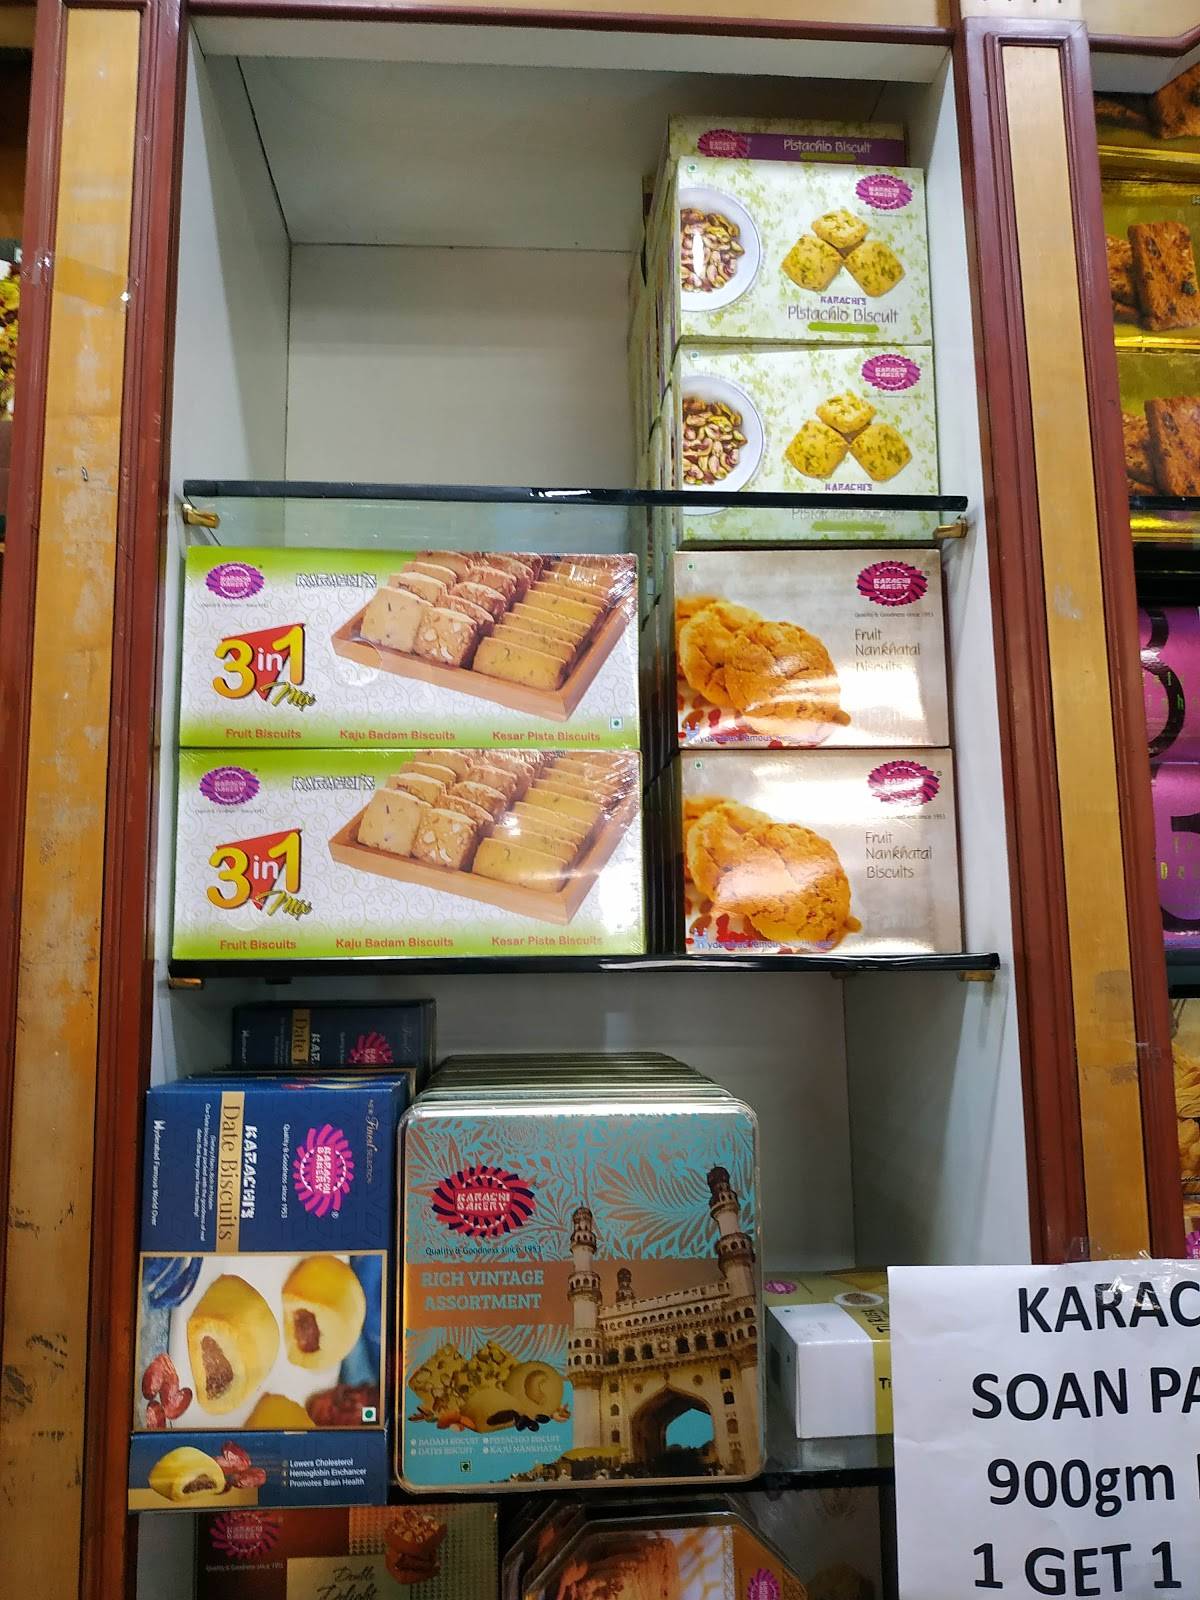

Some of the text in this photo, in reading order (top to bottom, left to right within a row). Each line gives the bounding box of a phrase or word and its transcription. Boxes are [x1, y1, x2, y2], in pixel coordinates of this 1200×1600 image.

[783, 139, 872, 153] Pistachio Biscuit
[788, 304, 898, 324] Pistachio Biscuit
[855, 627, 882, 641] Fruit
[212, 625, 305, 699] 3 in 1
[225, 728, 302, 740] Fruit Biscuits
[339, 729, 455, 741] Kaju Badam Biscuits
[492, 731, 601, 742] Kesar Pista Biscuits
[865, 831, 894, 844] Fruit
[206, 831, 302, 910] 3 in 1
[866, 866, 915, 880] Biscuits
[220, 939, 297, 950] Fruit Biscuits
[336, 937, 454, 950] Kaju Badam Biscuits
[491, 935, 602, 946] Kesar Pista Biscuits
[282, 1124, 290, 1147] Quality
[218, 1105, 240, 1240] Date Biscuits
[241, 1125, 258, 1219] KARACHI'S
[281, 1153, 289, 1184] Goodness
[315, 1146, 323, 1192] BAKERY
[323, 1146, 331, 1194] KARACHI
[457, 1192, 510, 1202] KARACHI
[281, 1203, 289, 1218] 1953
[457, 1201, 507, 1211] BAKERY
[420, 1270, 545, 1288] RICH VINTAGE
[424, 1294, 542, 1311] ASSORTMENT
[1018, 1281, 1200, 1333] KARAC
[972, 1368, 1128, 1421] SOAN
[289, 1458, 353, 1467] Lowers Cholesterol
[289, 1469, 330, 1478] Hemoglobin
[323, 1479, 341, 1487] Brain
[342, 1478, 364, 1486] Health
[987, 1458, 1175, 1517] 900gm
[973, 1541, 1182, 1597] 1 GET 1
